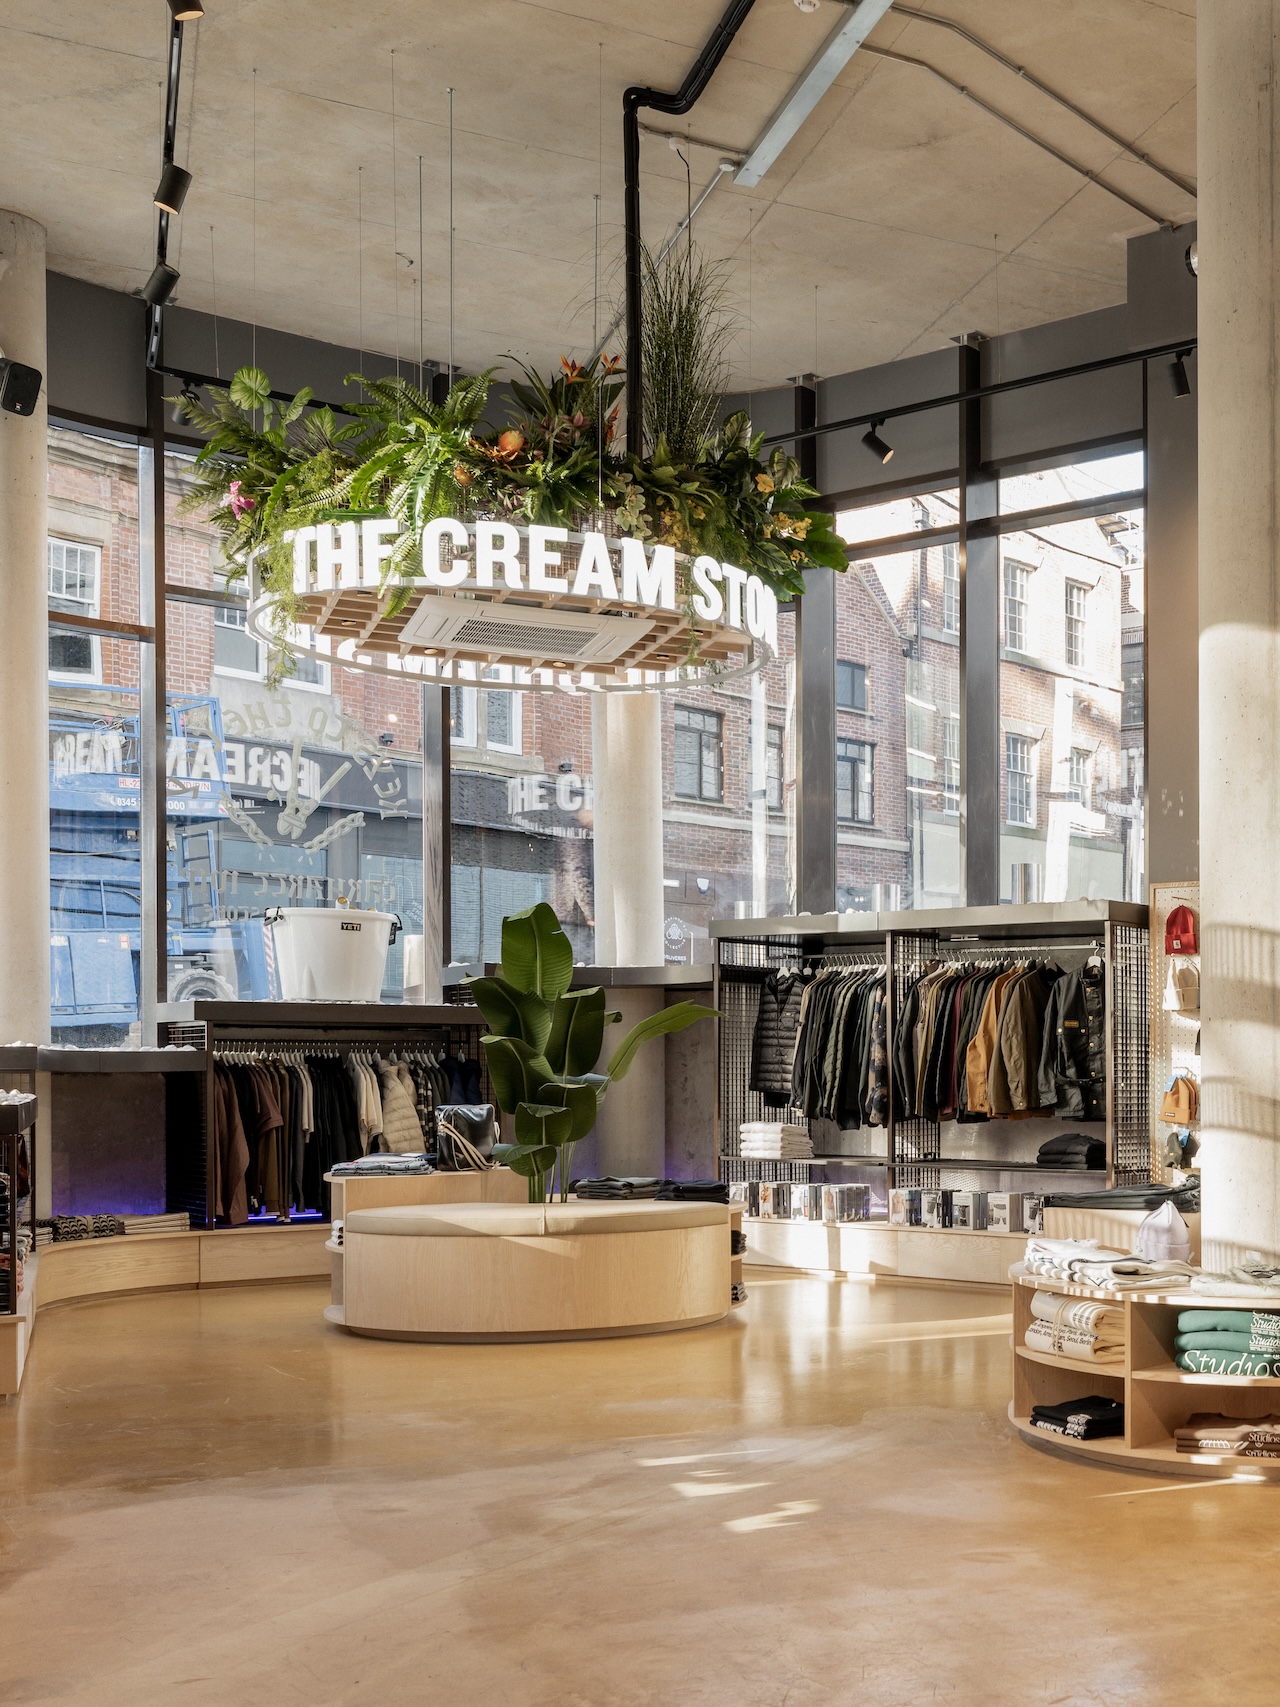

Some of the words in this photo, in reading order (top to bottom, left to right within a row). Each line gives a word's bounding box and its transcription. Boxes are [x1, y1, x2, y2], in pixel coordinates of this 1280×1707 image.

[284, 519, 401, 593] THE
[422, 517, 675, 610] CREAM
[117, 797, 136, 806] 0345
[341, 923, 361, 931] YETI
[1078, 1337, 1092, 1345] Berlin
[1249, 1432, 1280, 1443] Studios
